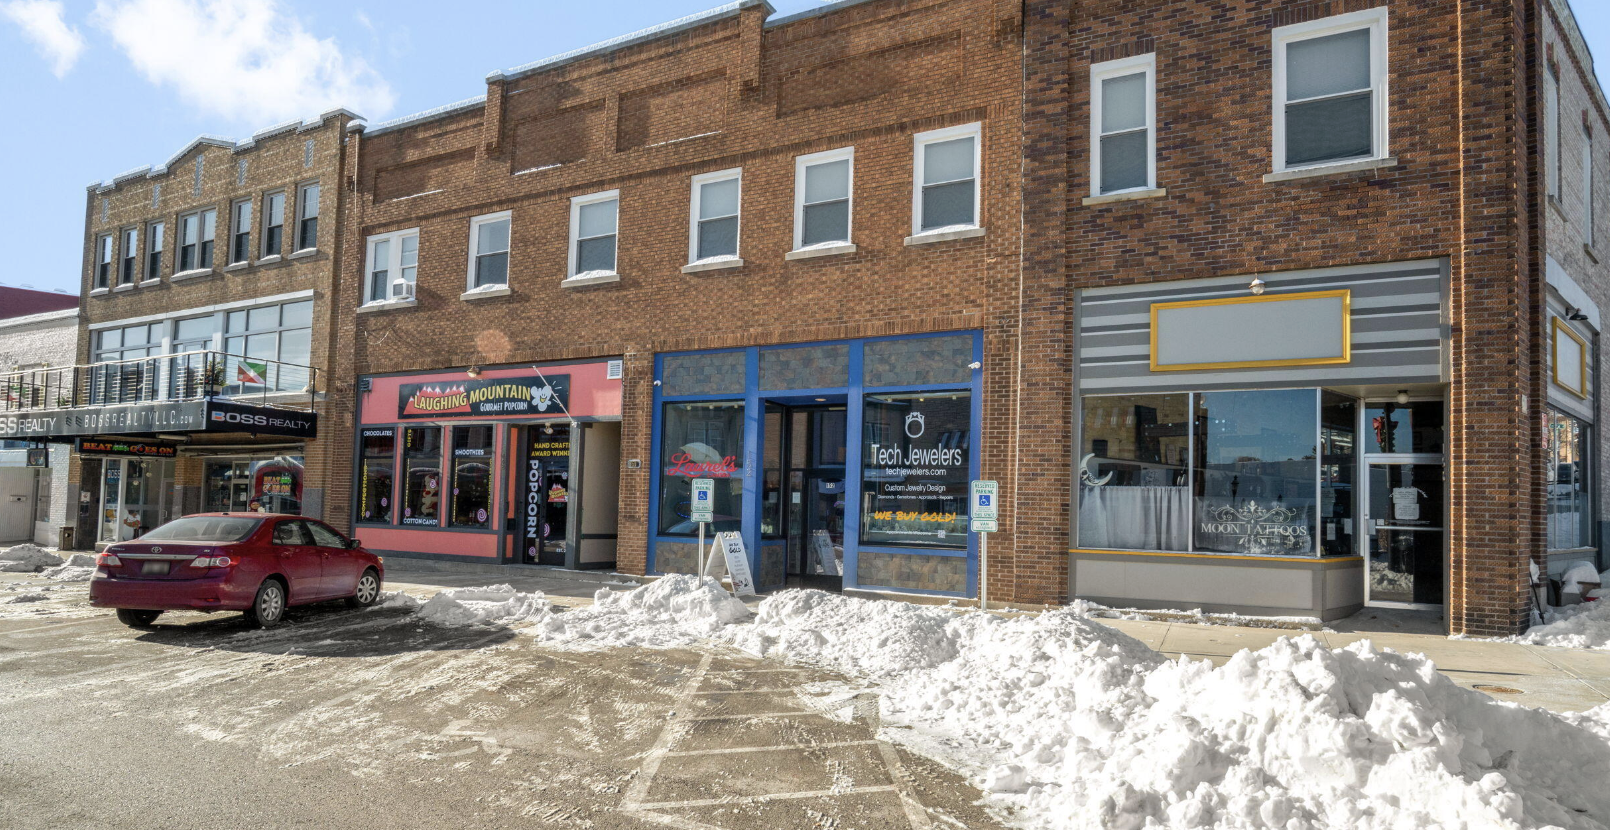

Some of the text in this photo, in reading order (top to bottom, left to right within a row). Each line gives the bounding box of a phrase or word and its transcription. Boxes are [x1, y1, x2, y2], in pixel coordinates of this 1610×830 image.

[414, 384, 530, 410] LAUGHING MOUNTAIN
[504, 402, 528, 410] POPCORN
[18, 418, 56, 432] REALTY
[212, 410, 311, 429] BOSS REALTY
[83, 442, 112, 450] BEAT
[872, 443, 962, 466] Tech Jewelers
[667, 453, 738, 478] Laurel's
[886, 467, 946, 476] techjewelers.com
[906, 484, 926, 493] Jewelry
[927, 484, 946, 493] Design
[527, 460, 539, 538] POPCORN
[874, 511, 956, 524] WE BUY GOLD!
[1201, 523, 1307, 536] MOON TATTOOS
